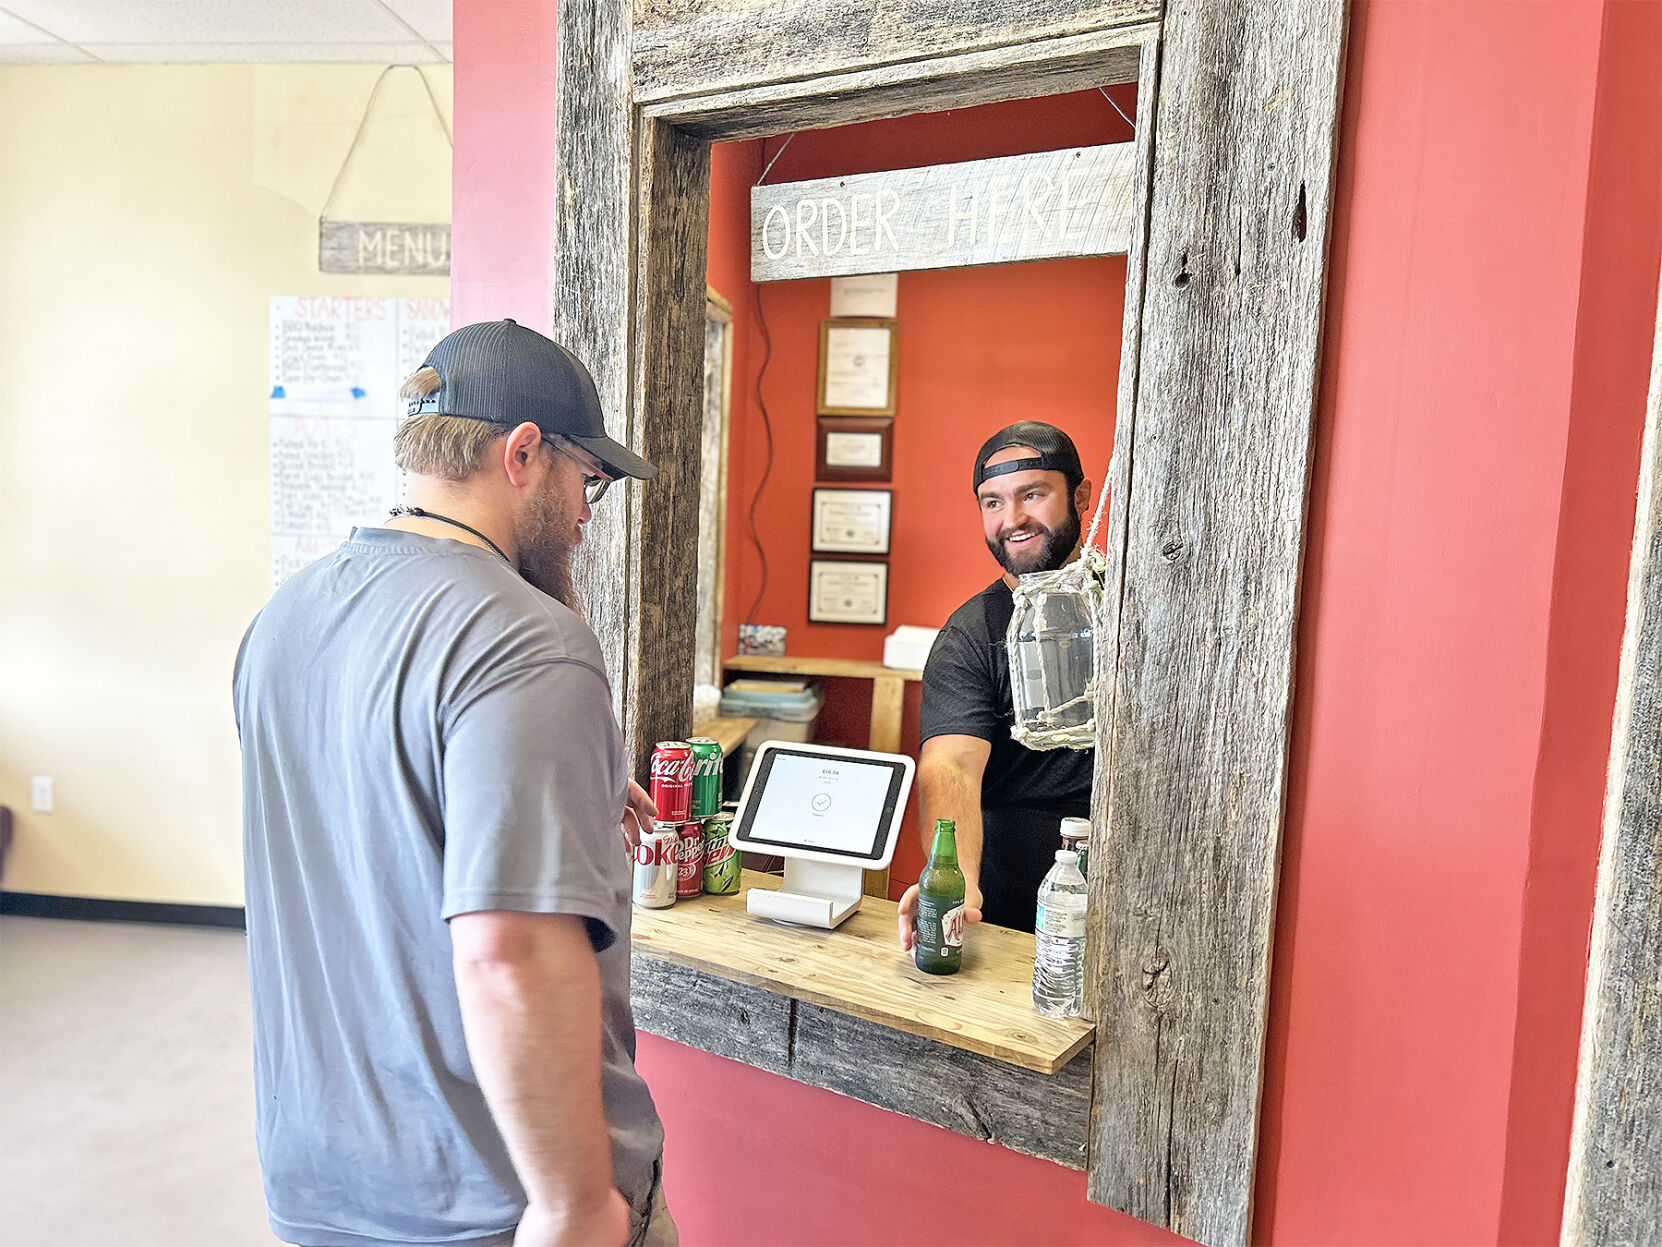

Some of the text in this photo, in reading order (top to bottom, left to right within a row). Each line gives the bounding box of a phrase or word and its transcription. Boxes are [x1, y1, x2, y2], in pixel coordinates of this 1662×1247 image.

[762, 167, 1091, 260] ORDER HERE
[358, 229, 448, 268] MENU
[295, 296, 387, 321] STARTERS
[634, 839, 679, 866] oke
[684, 836, 700, 850] Dr
